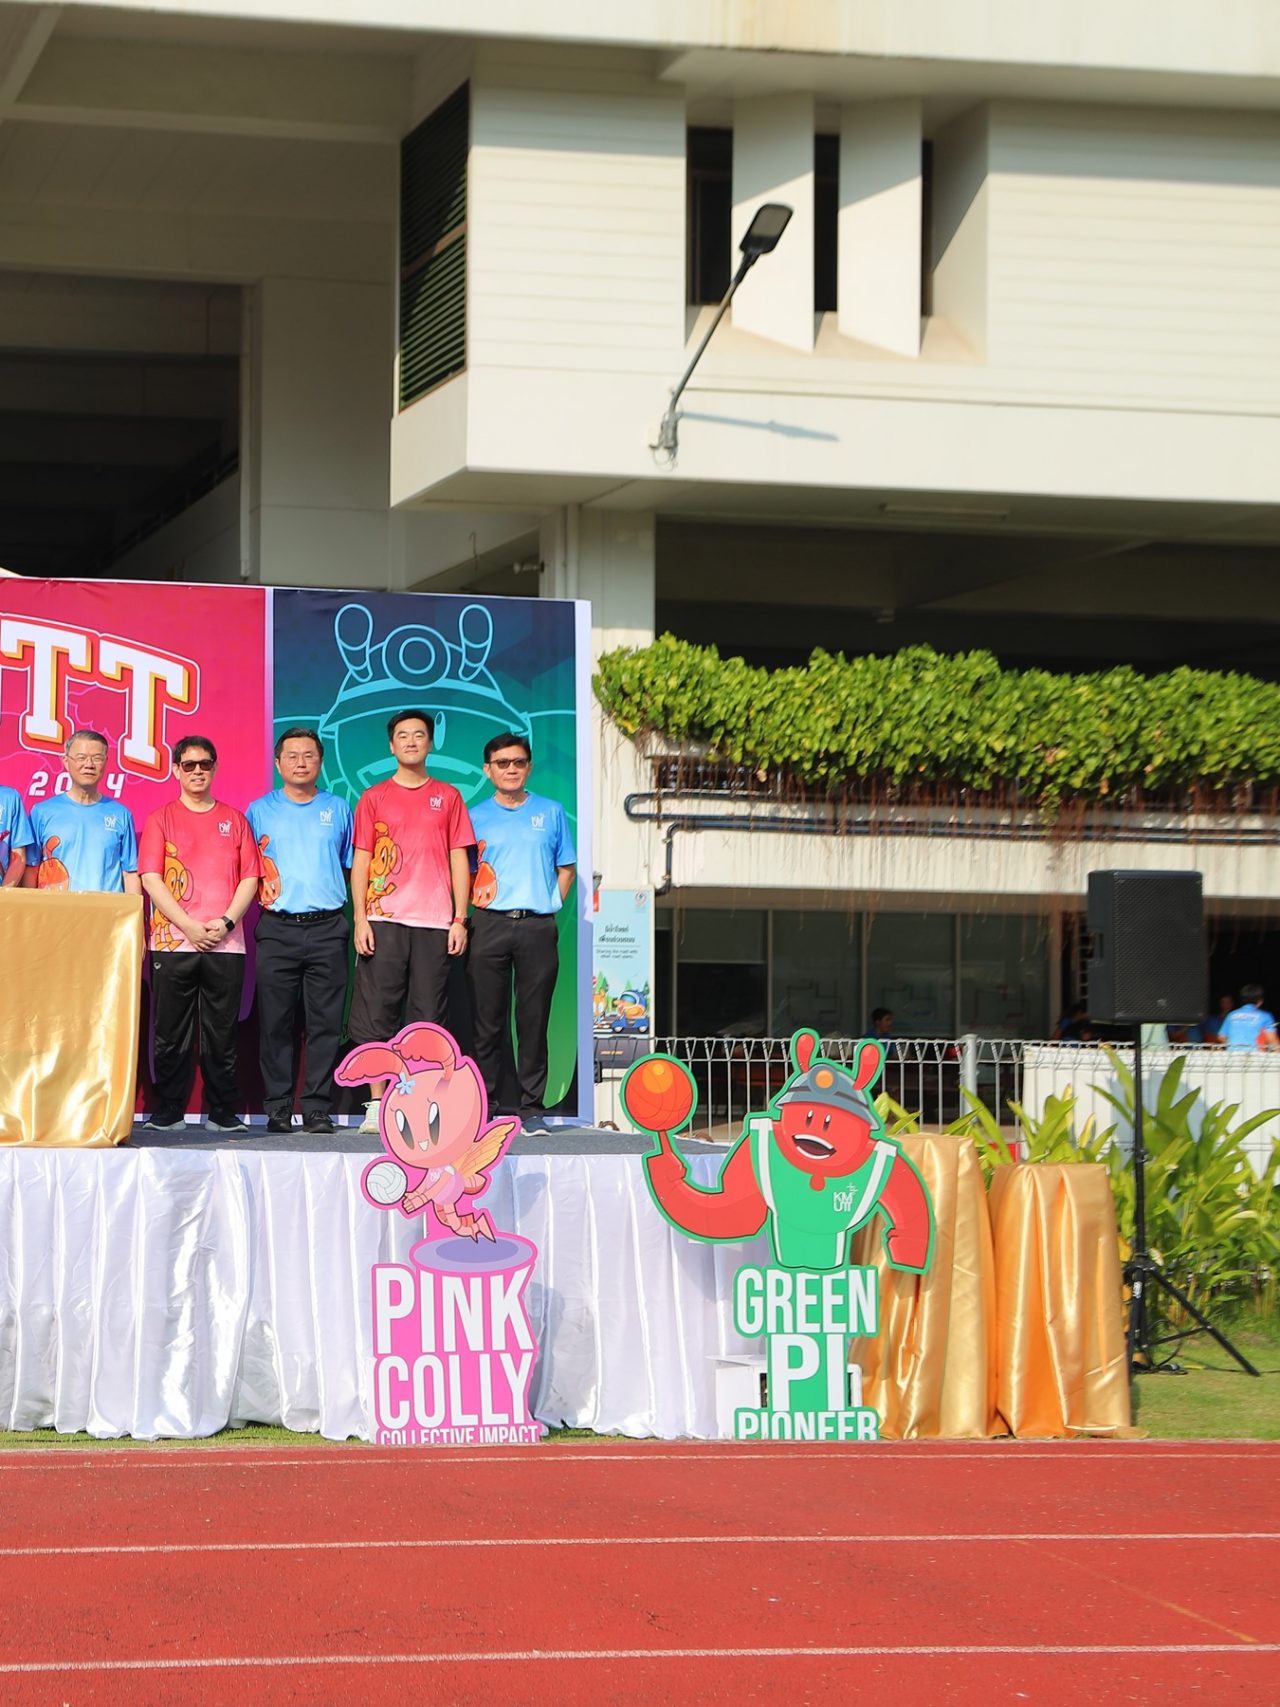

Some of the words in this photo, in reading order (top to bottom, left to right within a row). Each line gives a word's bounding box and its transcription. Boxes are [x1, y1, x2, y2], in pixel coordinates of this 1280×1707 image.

[28, 771, 125, 798] 204
[376, 1265, 534, 1354] PINK
[737, 1268, 877, 1334] GREEN
[378, 1352, 534, 1430] COLLY
[770, 1334, 847, 1412] PI
[479, 1425, 538, 1444] IMPACT
[738, 1411, 877, 1440] PIONEER
